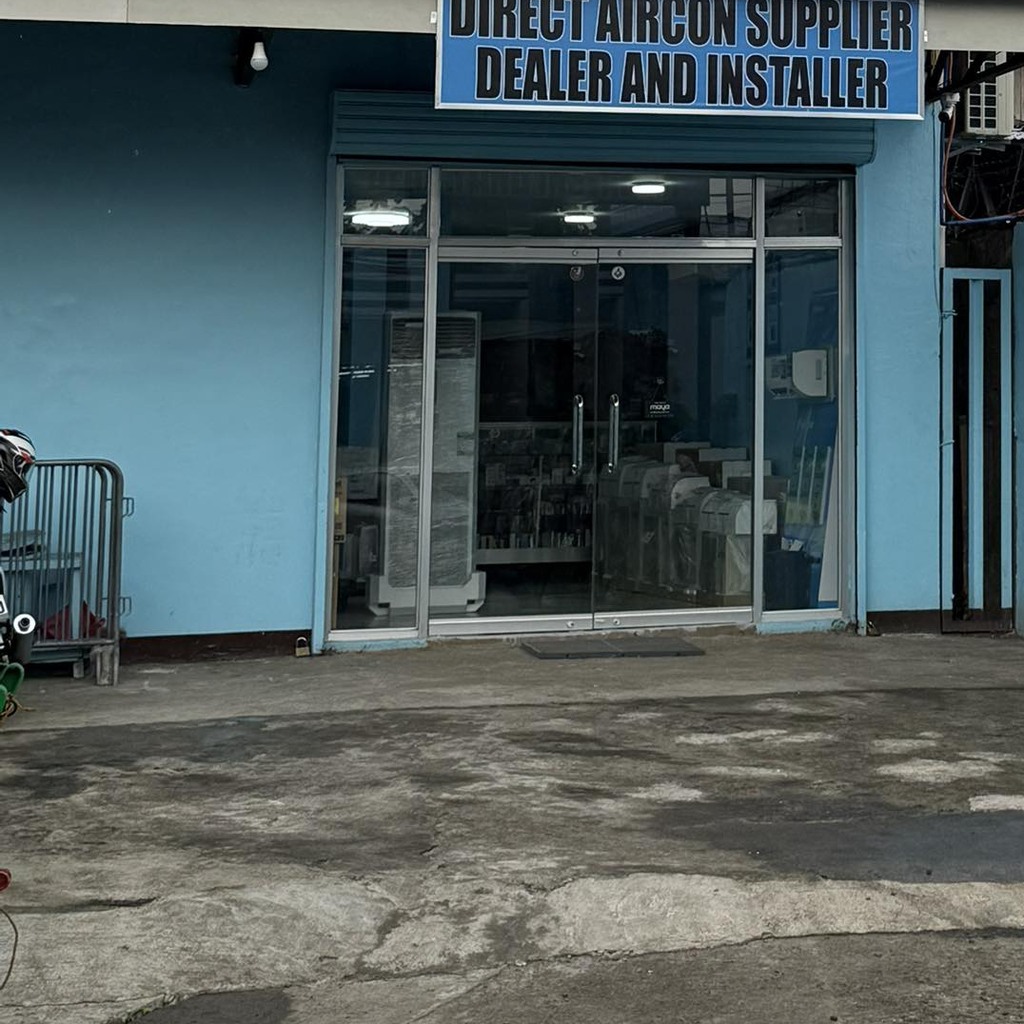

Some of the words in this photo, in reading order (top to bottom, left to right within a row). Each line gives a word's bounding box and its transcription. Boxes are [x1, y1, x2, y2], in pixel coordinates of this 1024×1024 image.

[475, 46, 611, 103] DEALER
[619, 50, 698, 106] AND
[707, 53, 888, 110] INSTALLER
